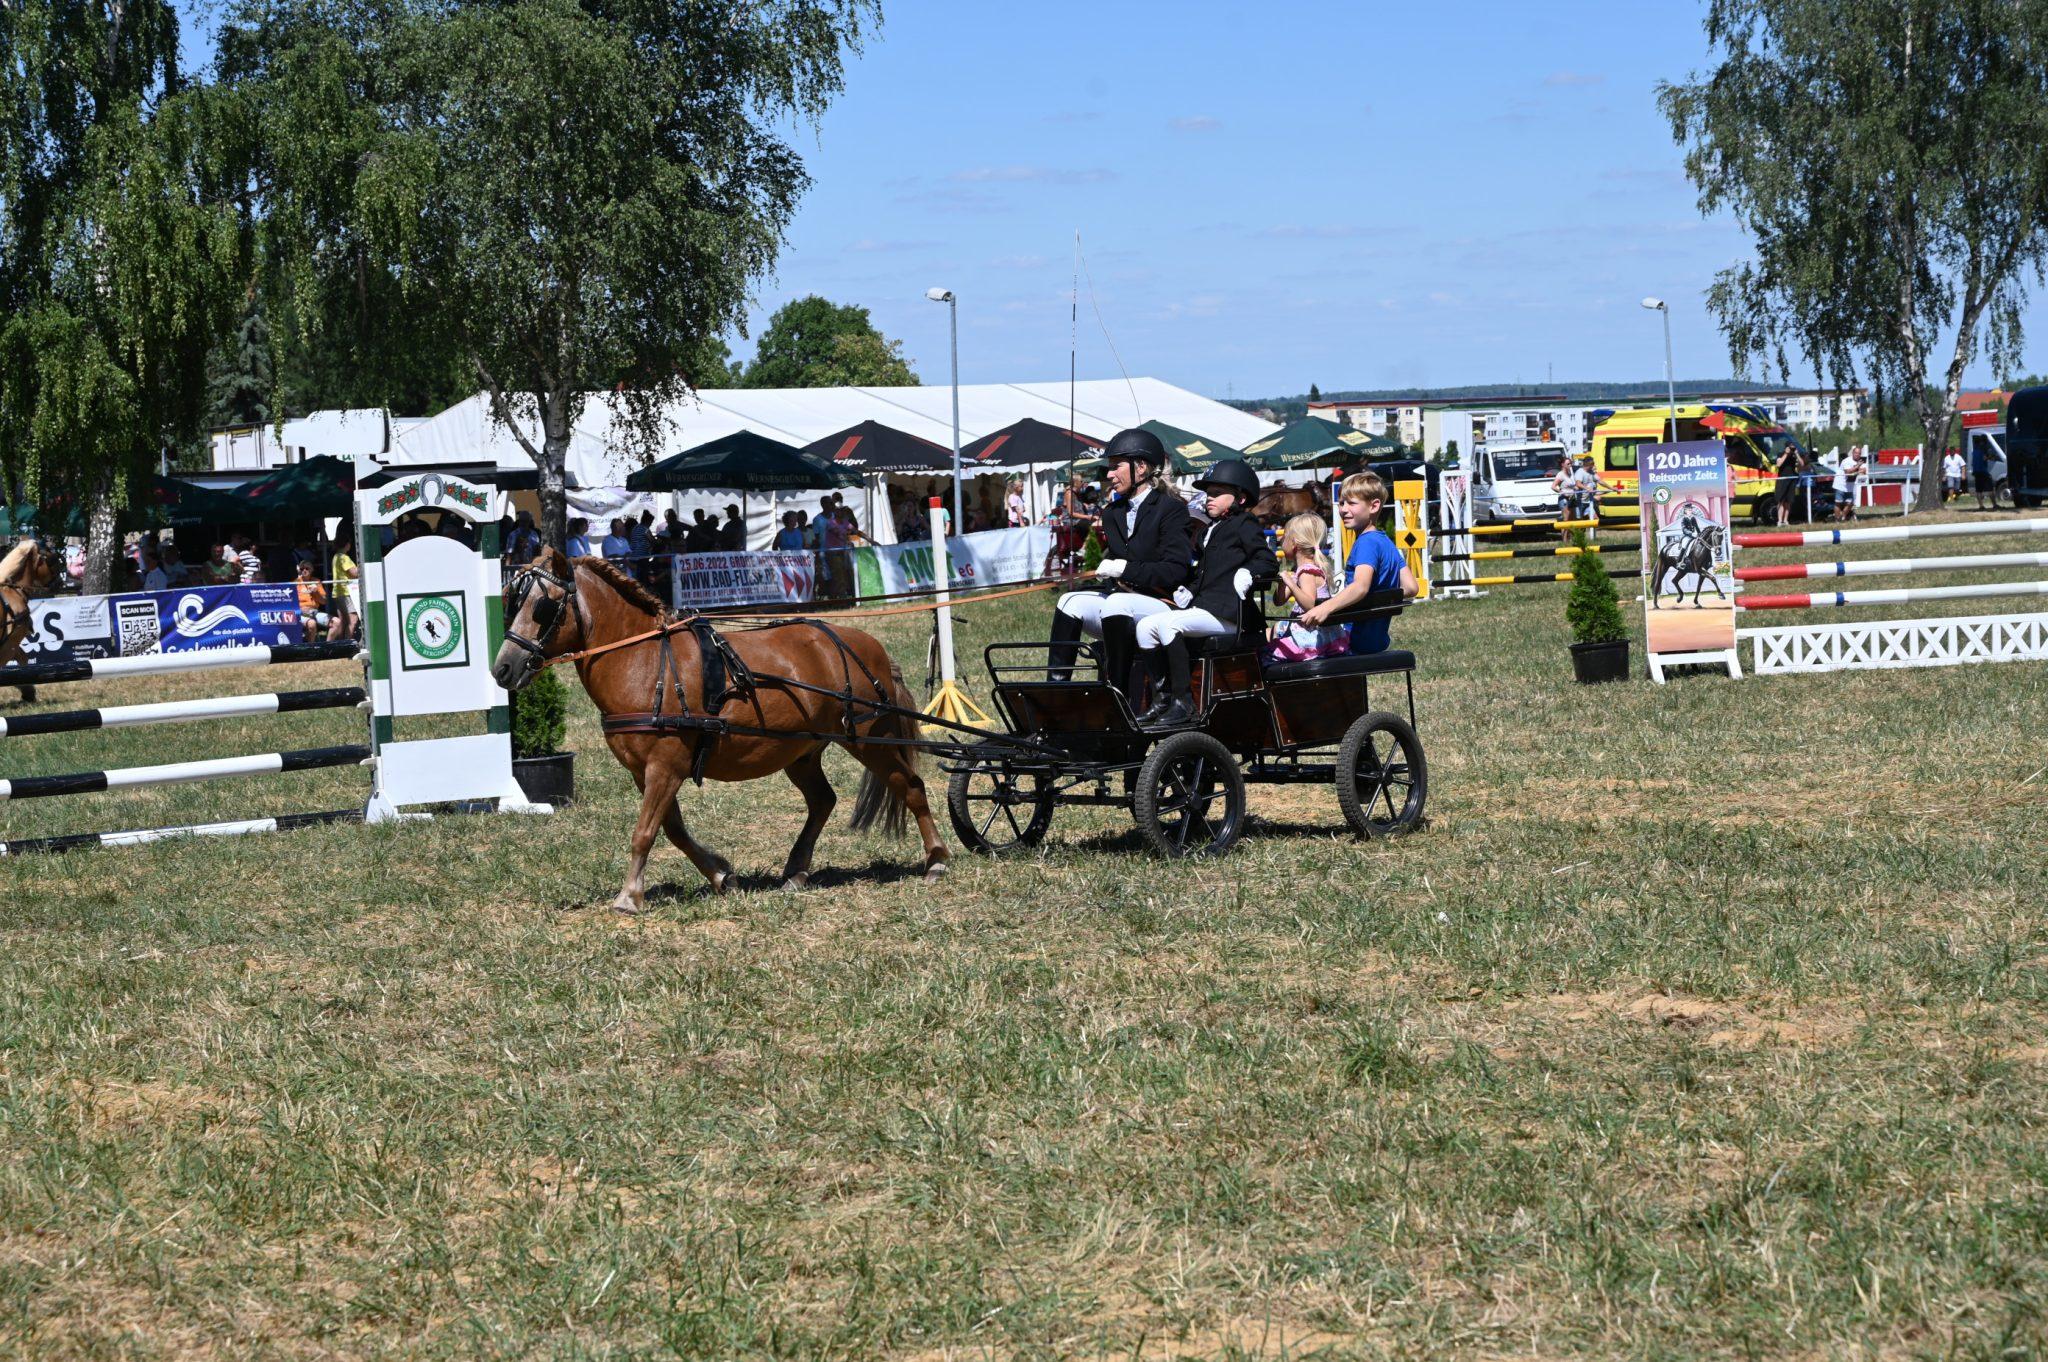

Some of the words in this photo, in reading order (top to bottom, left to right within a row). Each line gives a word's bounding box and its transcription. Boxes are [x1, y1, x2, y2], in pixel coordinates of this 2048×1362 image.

[1646, 452, 1681, 470] 120
[1682, 454, 1718, 468] Jahre
[1648, 472, 1692, 483] Reitsport
[1694, 470, 1719, 481] Zeitz
[681, 556, 729, 572] 25.06.2022
[958, 562, 974, 578] eG
[680, 567, 779, 590] WWW.BAD-FLIESE.DE
[121, 607, 139, 615] SCAN
[260, 611, 282, 624] BLK
[284, 611, 293, 623] tv
